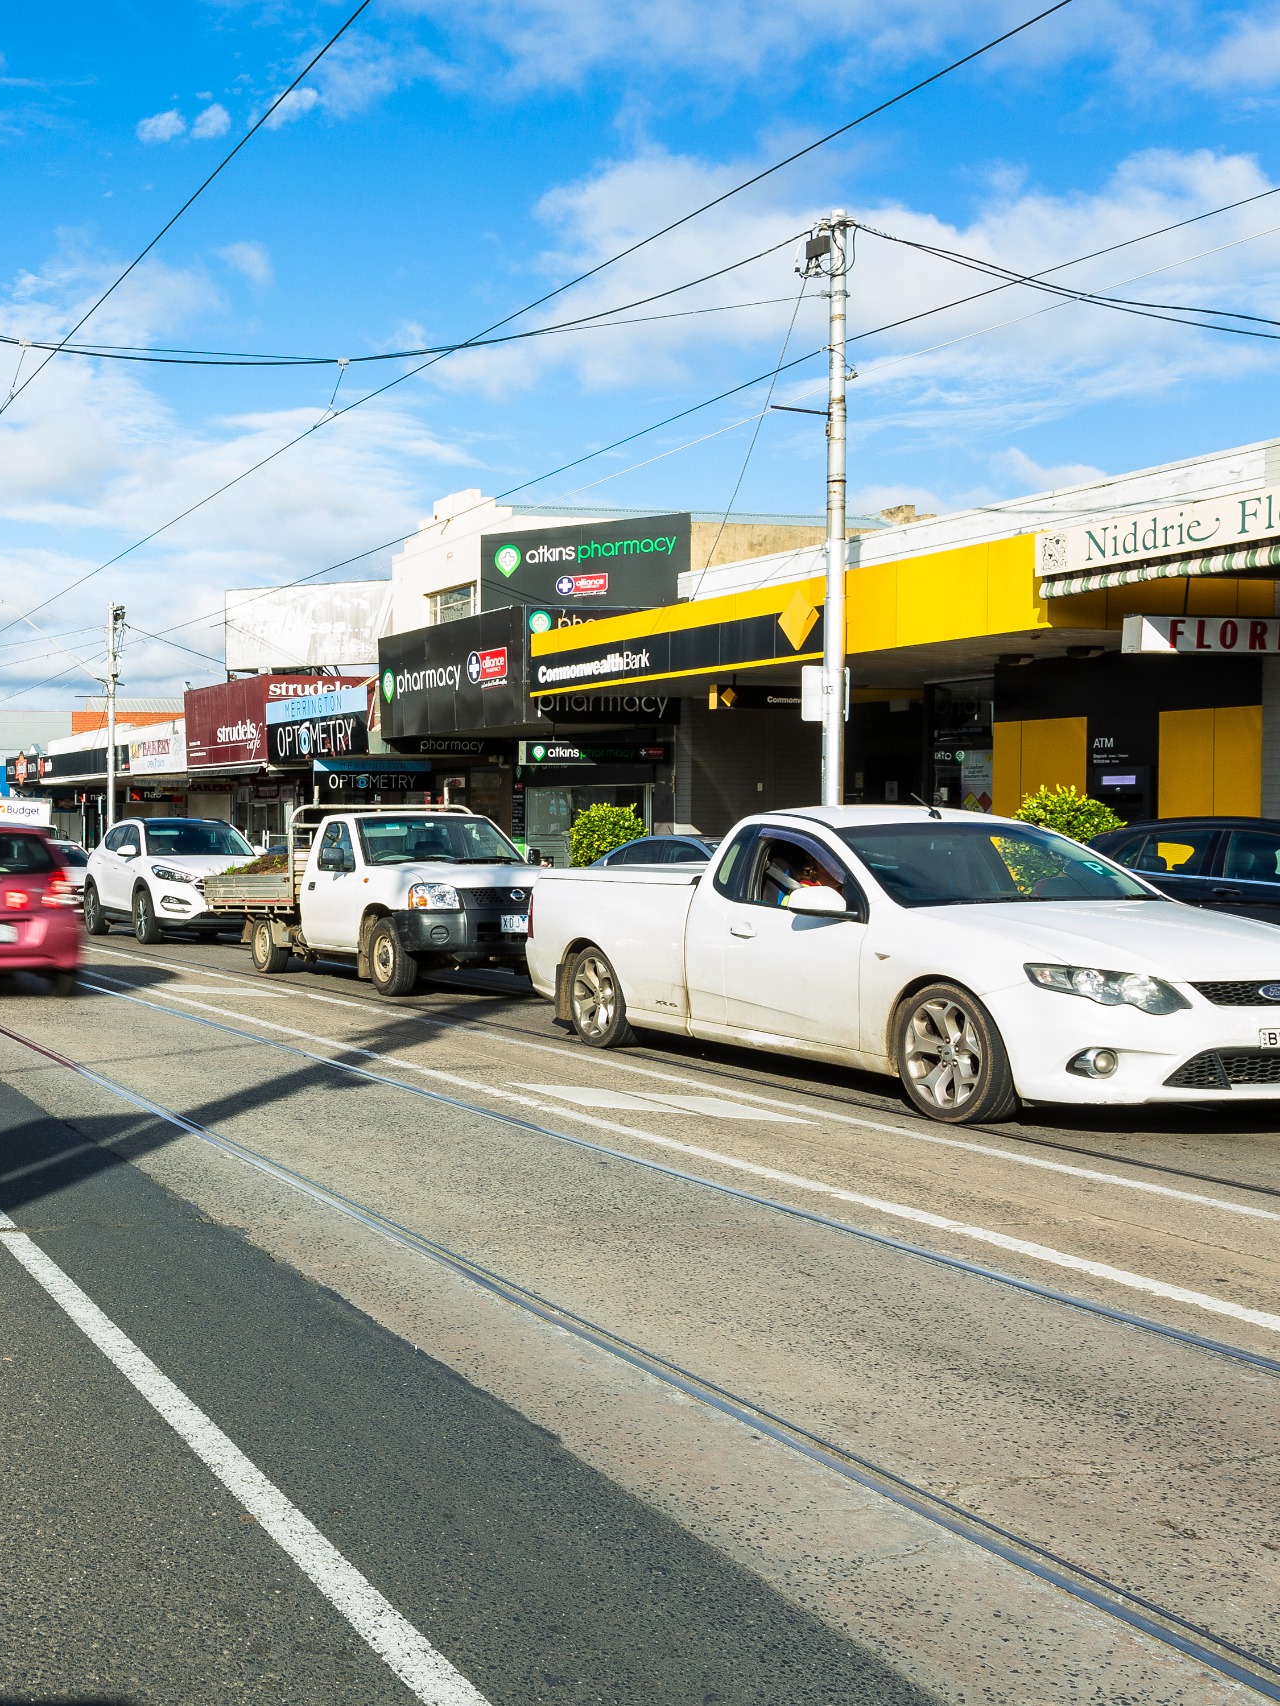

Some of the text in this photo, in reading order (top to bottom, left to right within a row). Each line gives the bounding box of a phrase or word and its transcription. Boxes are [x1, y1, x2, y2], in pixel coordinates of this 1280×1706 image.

[1084, 494, 1280, 562] Niddrie Fl
[525, 536, 677, 564] atkins pharmacy
[575, 578, 605, 587] alliance
[482, 656, 505, 669] alliance
[396, 664, 461, 700] pharmacy
[284, 694, 342, 718] MERRINGTON
[767, 696, 802, 704] Common
[537, 696, 669, 719] pharmacy
[217, 719, 257, 743] strudels
[277, 718, 355, 757] OPTOMETRY
[142, 739, 170, 757] BAKERY
[420, 739, 484, 753] pharmacy
[1093, 737, 1114, 748] ATM
[547, 747, 580, 758] atkins
[340, 761, 407, 770] MERRINGTON
[328, 773, 416, 789] OPTOMETRY
[90, 793, 106, 801] nab
[144, 791, 162, 799] nab
[6, 805, 40, 817] Budget
[1082, 861, 1104, 875] P
